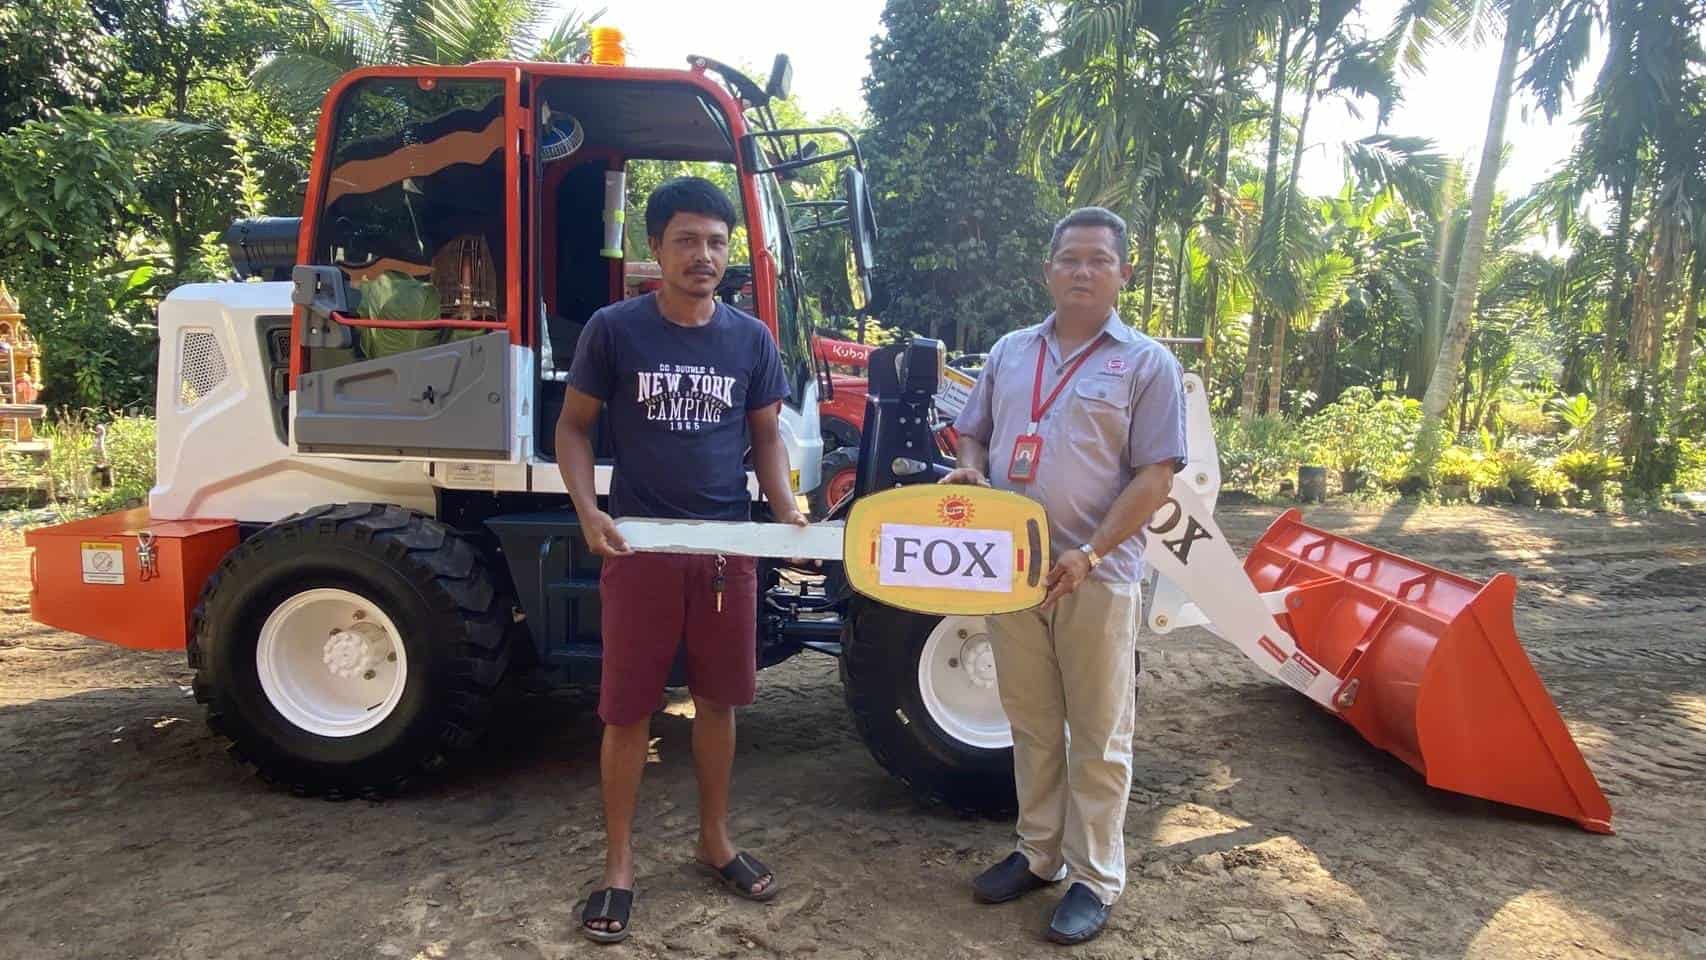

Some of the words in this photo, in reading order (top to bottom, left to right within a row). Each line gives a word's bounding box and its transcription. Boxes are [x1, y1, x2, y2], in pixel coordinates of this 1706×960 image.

[832, 344, 869, 361] Kubot
[675, 364, 706, 374] DOUBLE
[637, 372, 682, 402] NEW
[688, 375, 736, 408] YORK
[647, 397, 721, 422] CAMPING
[670, 421, 701, 431] 1965
[1147, 496, 1213, 565] OX
[892, 536, 998, 579] FOX
